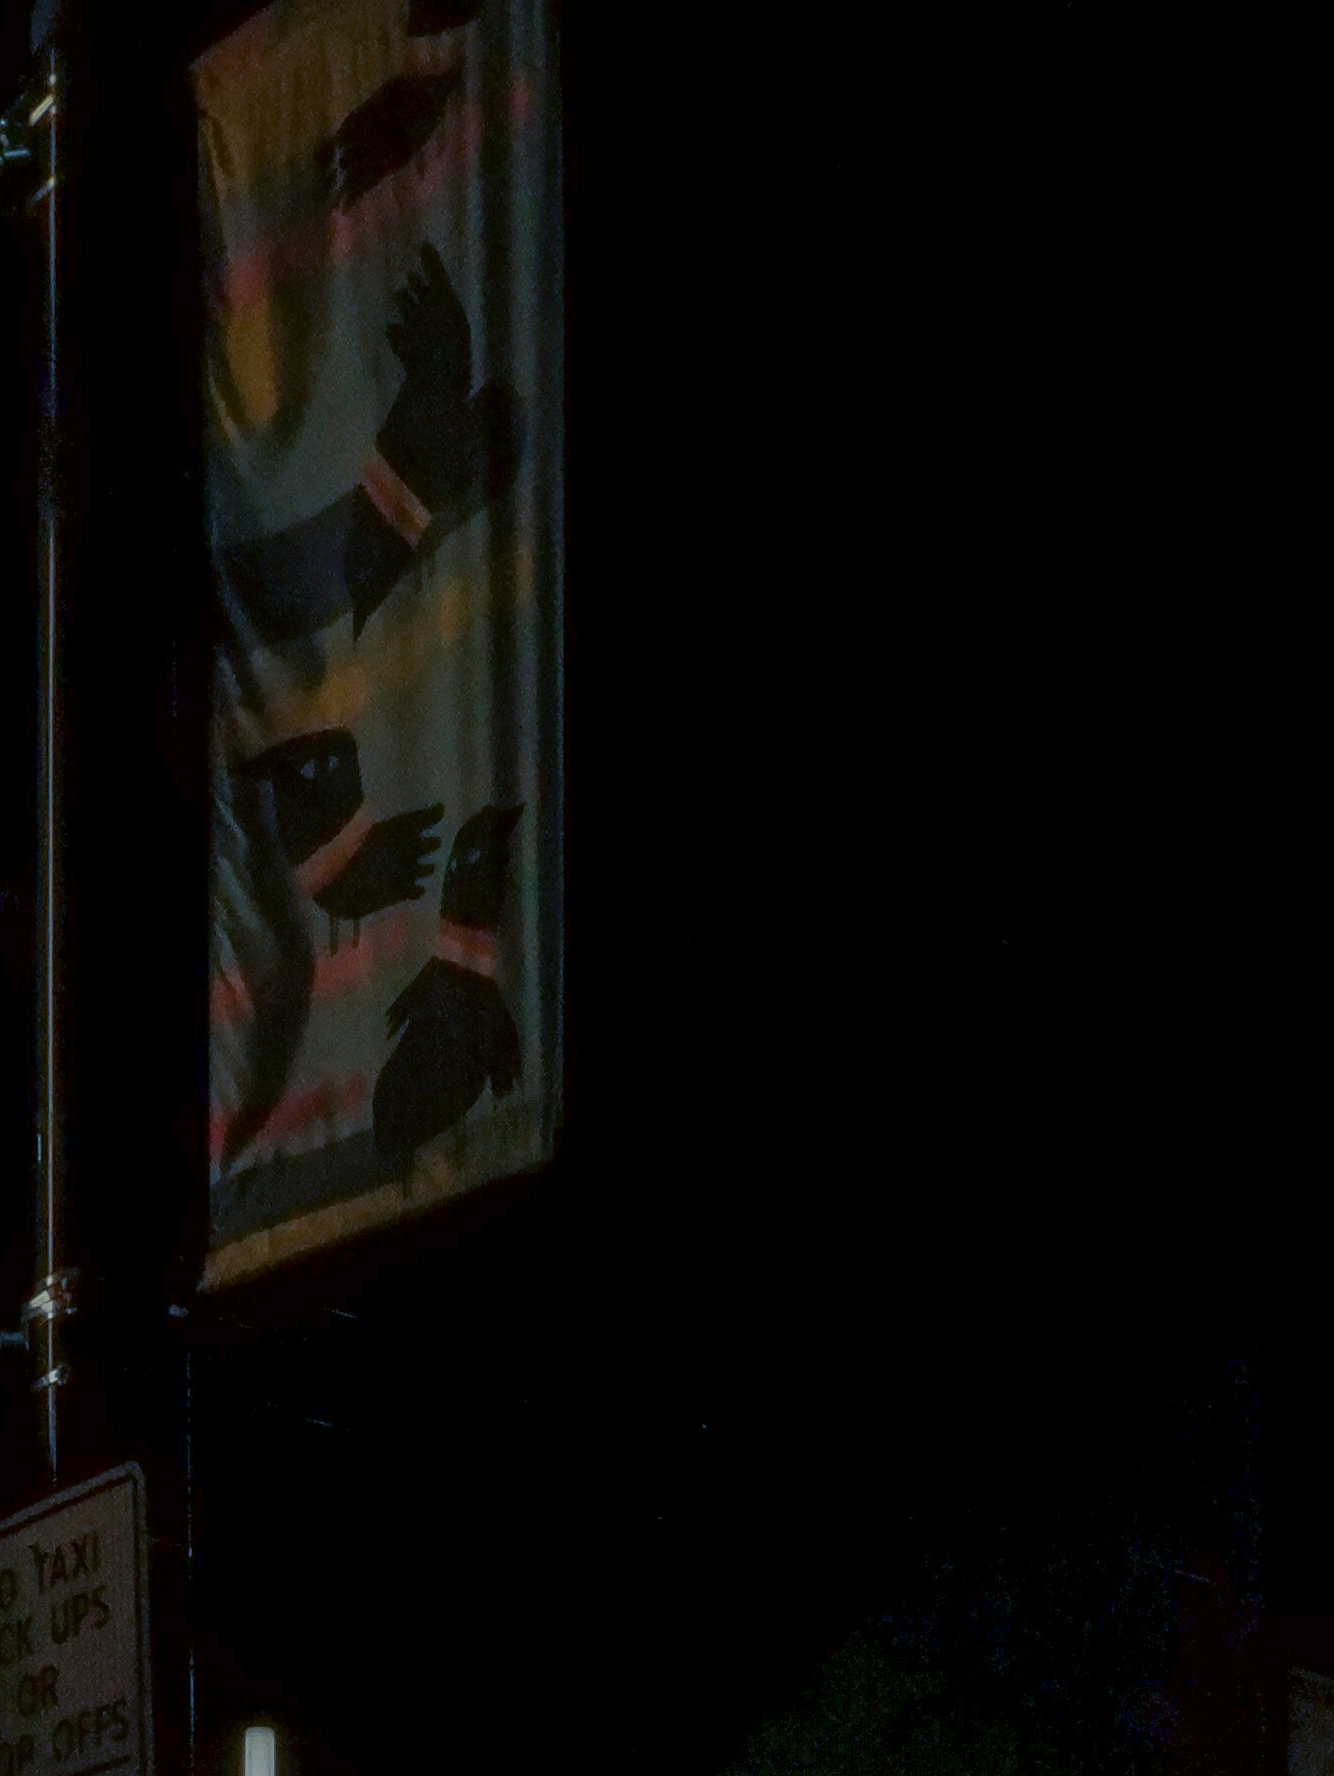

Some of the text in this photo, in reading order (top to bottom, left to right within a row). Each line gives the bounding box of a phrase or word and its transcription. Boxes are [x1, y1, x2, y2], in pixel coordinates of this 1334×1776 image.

[30, 1532, 100, 1593] TAXI
[51, 1585, 110, 1645] UPS
[17, 1665, 60, 1718] OR
[52, 1698, 129, 1762] OFFS
